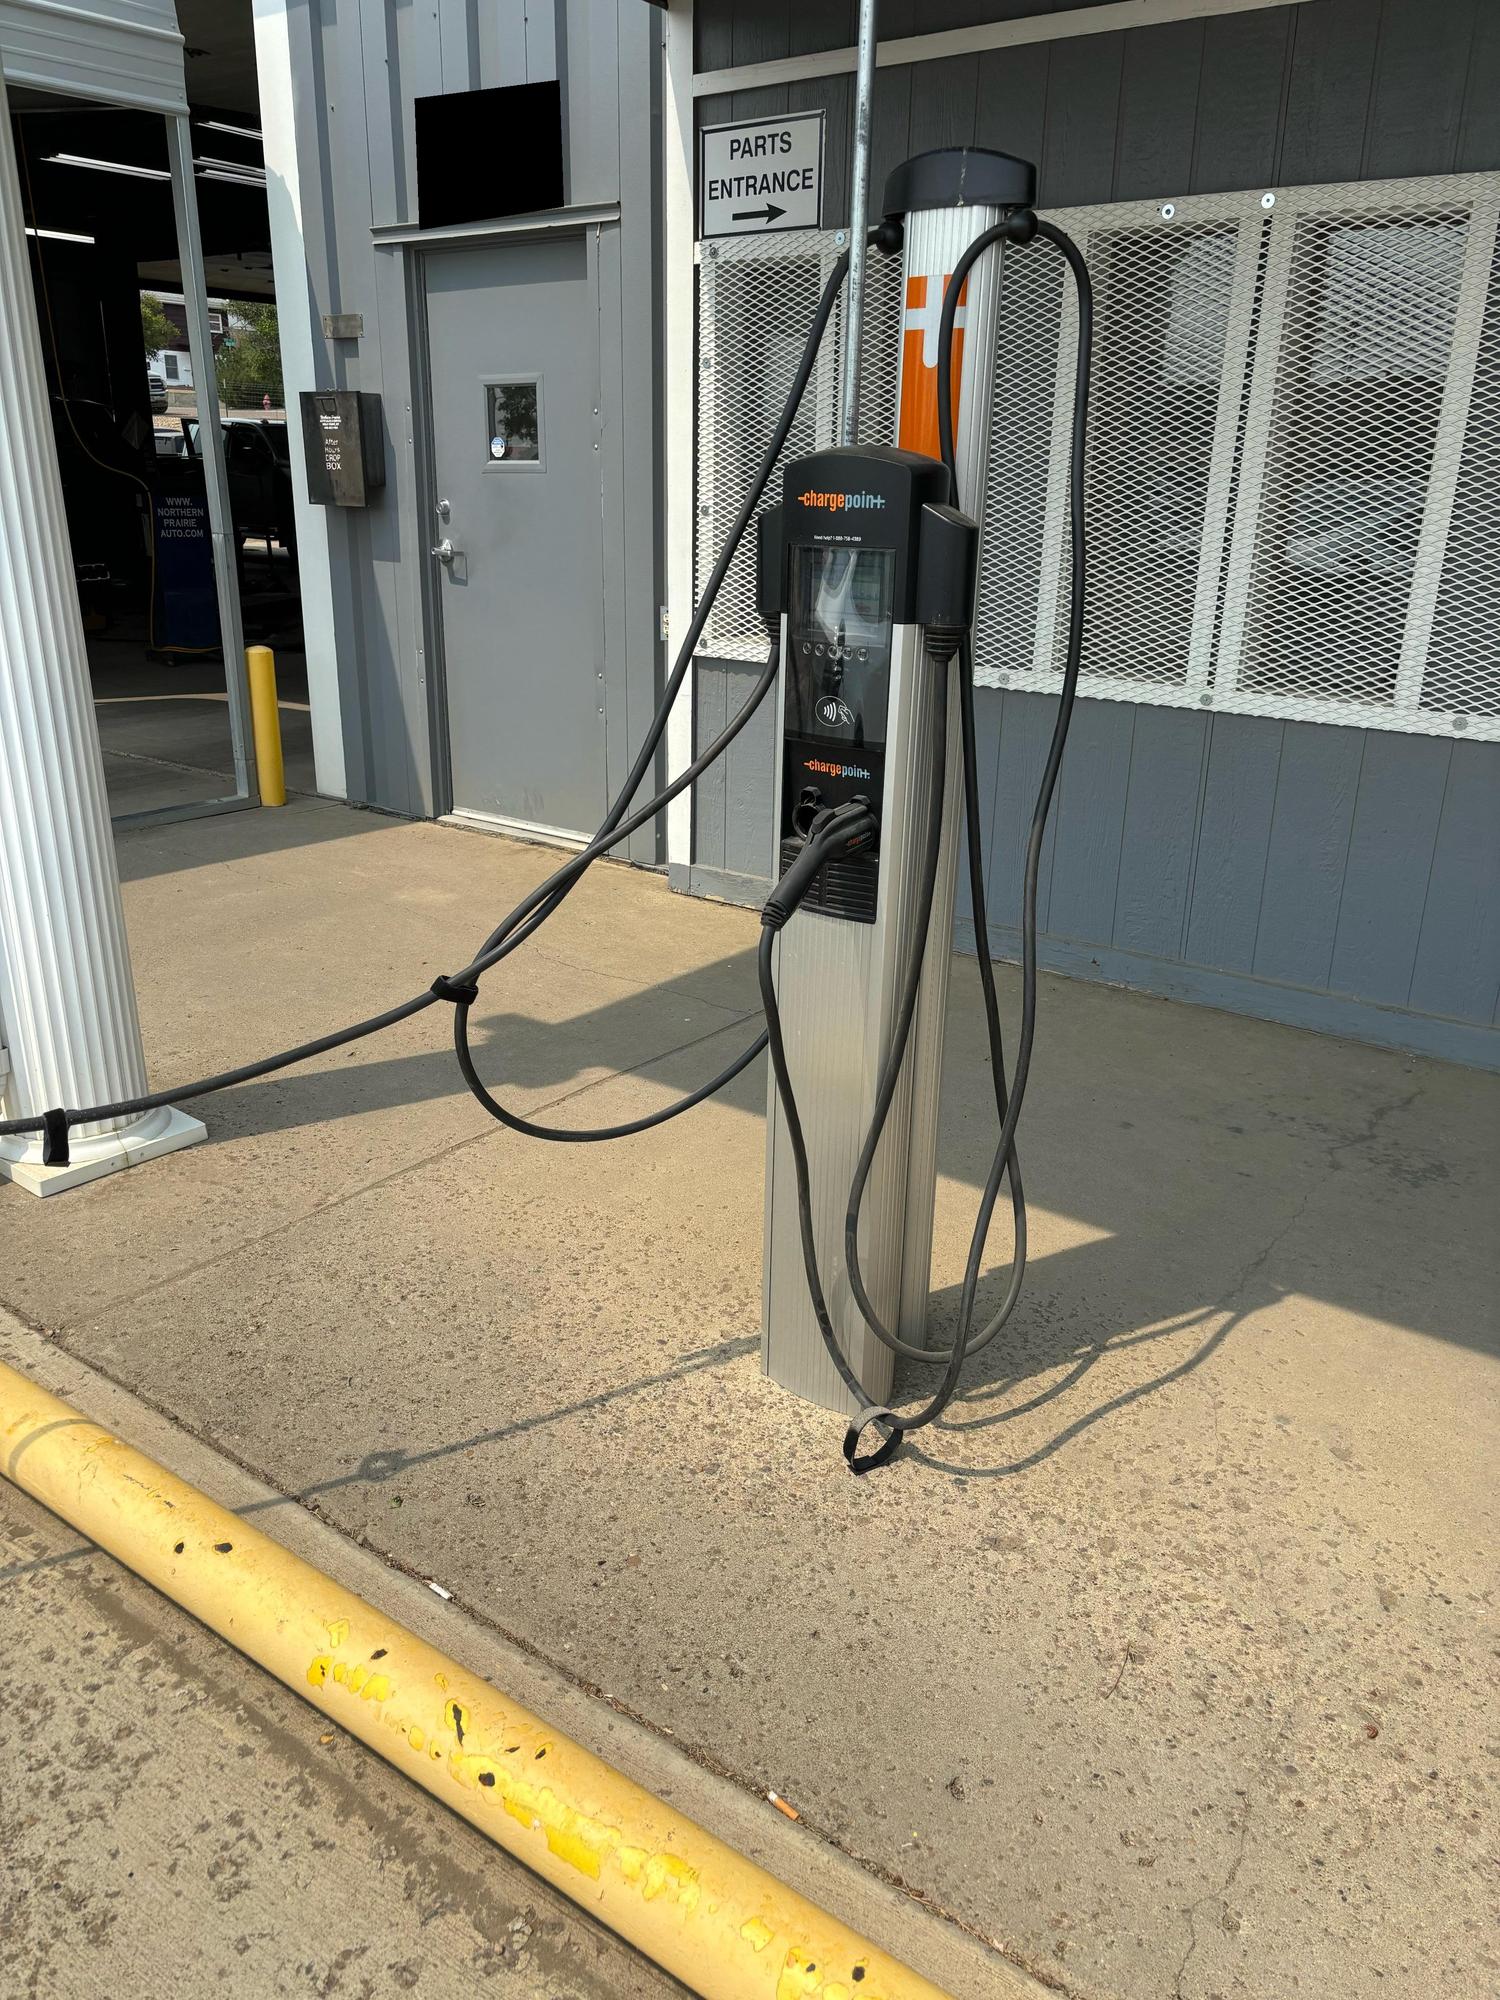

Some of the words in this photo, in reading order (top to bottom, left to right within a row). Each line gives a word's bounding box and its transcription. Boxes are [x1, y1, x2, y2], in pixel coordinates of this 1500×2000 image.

[730, 131, 792, 160] PARTS
[708, 167, 814, 200] ENTRANCE
[326, 462, 341, 470] BOX
[165, 497, 193, 506] WWW.
[157, 507, 204, 517] NORTHERN
[163, 518, 198, 527] PRAIRIE
[160, 529, 204, 538] AUTO.COM
